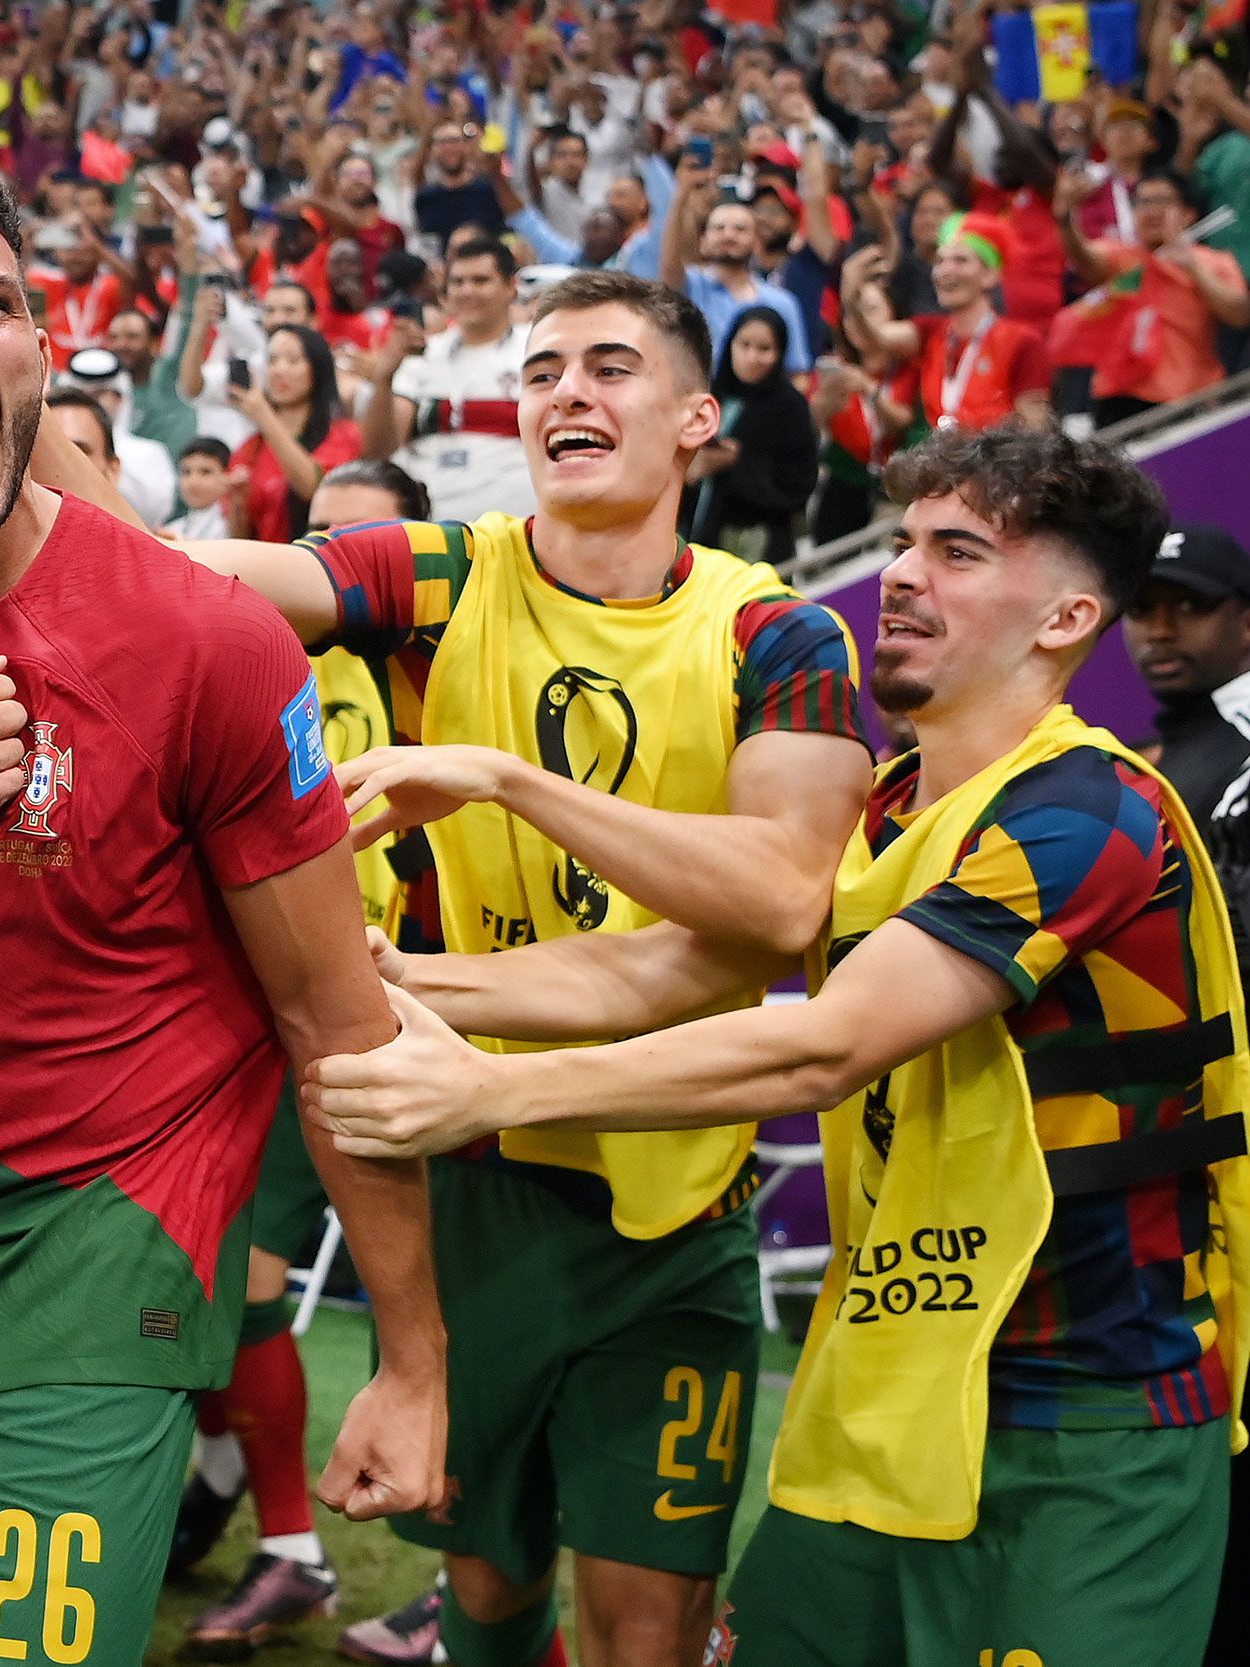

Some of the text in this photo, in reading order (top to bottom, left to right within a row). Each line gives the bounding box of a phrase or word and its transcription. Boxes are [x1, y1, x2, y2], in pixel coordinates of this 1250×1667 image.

[18, 865, 43, 878] DOHA
[50, 854, 73, 867] 2022
[847, 1226, 987, 1277] LD CUP
[848, 1272, 979, 1324] 2022
[656, 1365, 742, 1484] 24
